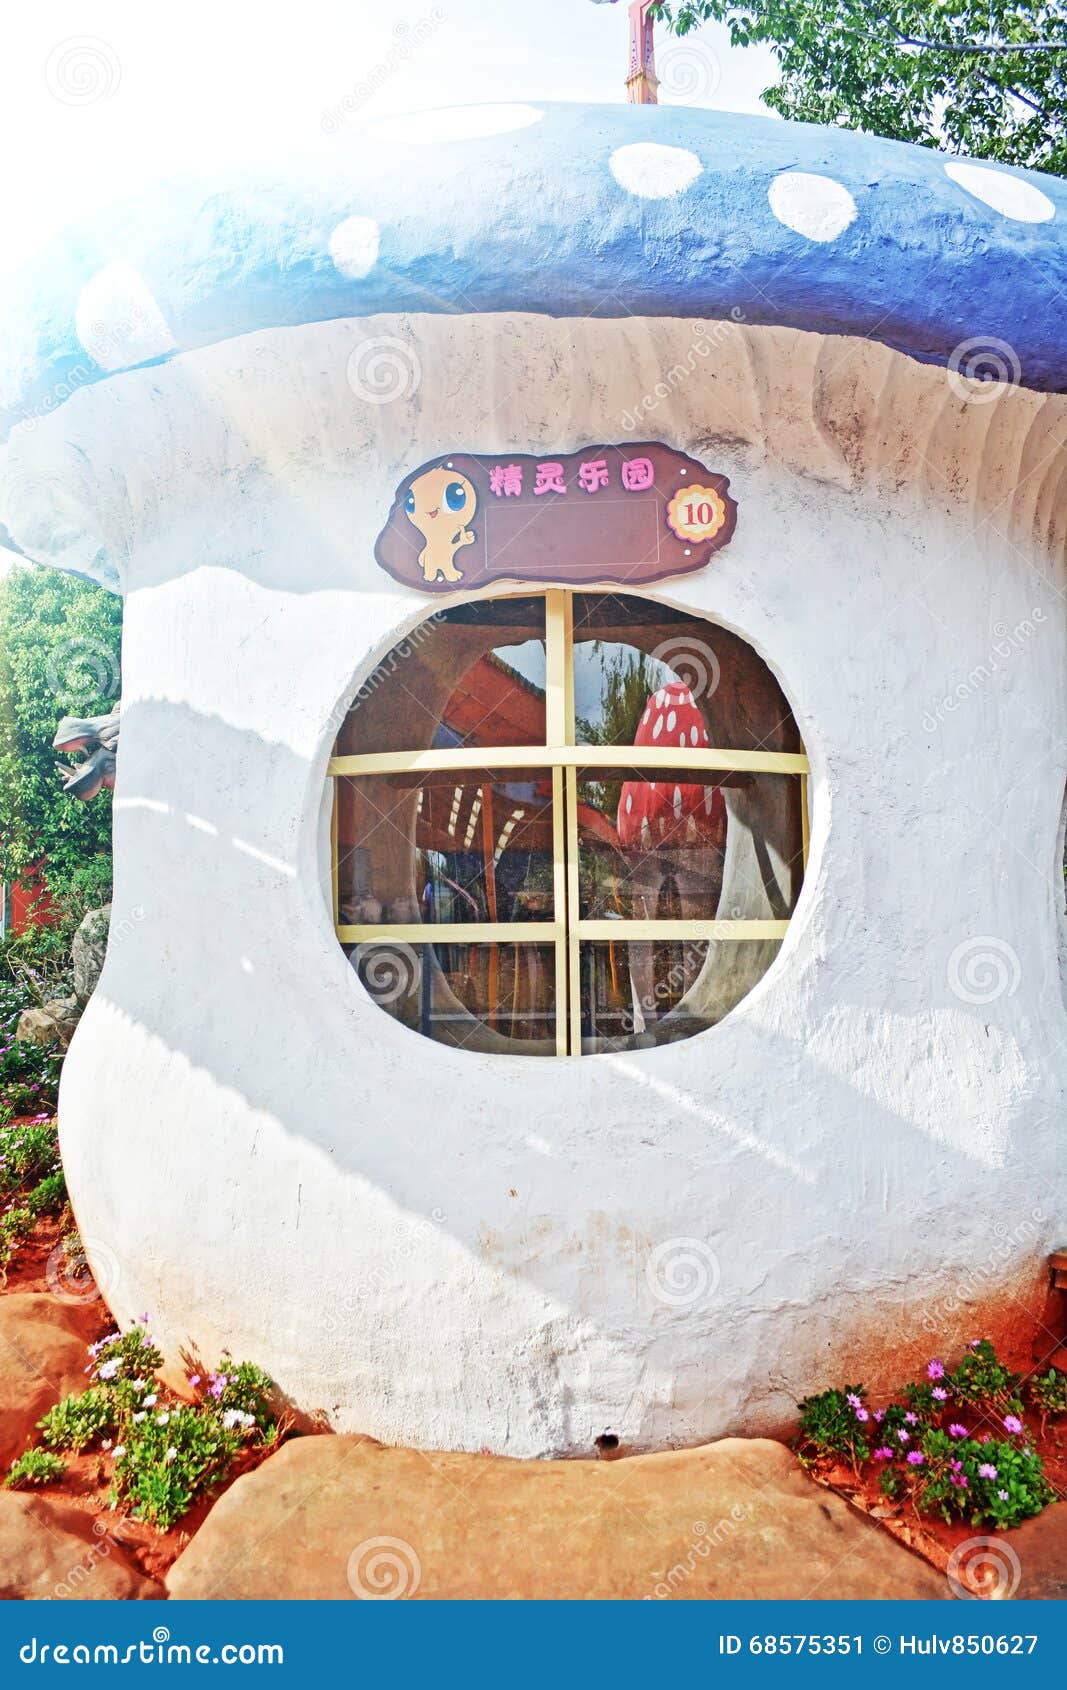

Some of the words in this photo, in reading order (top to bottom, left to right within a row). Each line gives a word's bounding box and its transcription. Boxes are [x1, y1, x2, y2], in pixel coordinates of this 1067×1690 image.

[488, 457, 655, 497] 精灵乐园
[683, 501, 714, 527] 10
